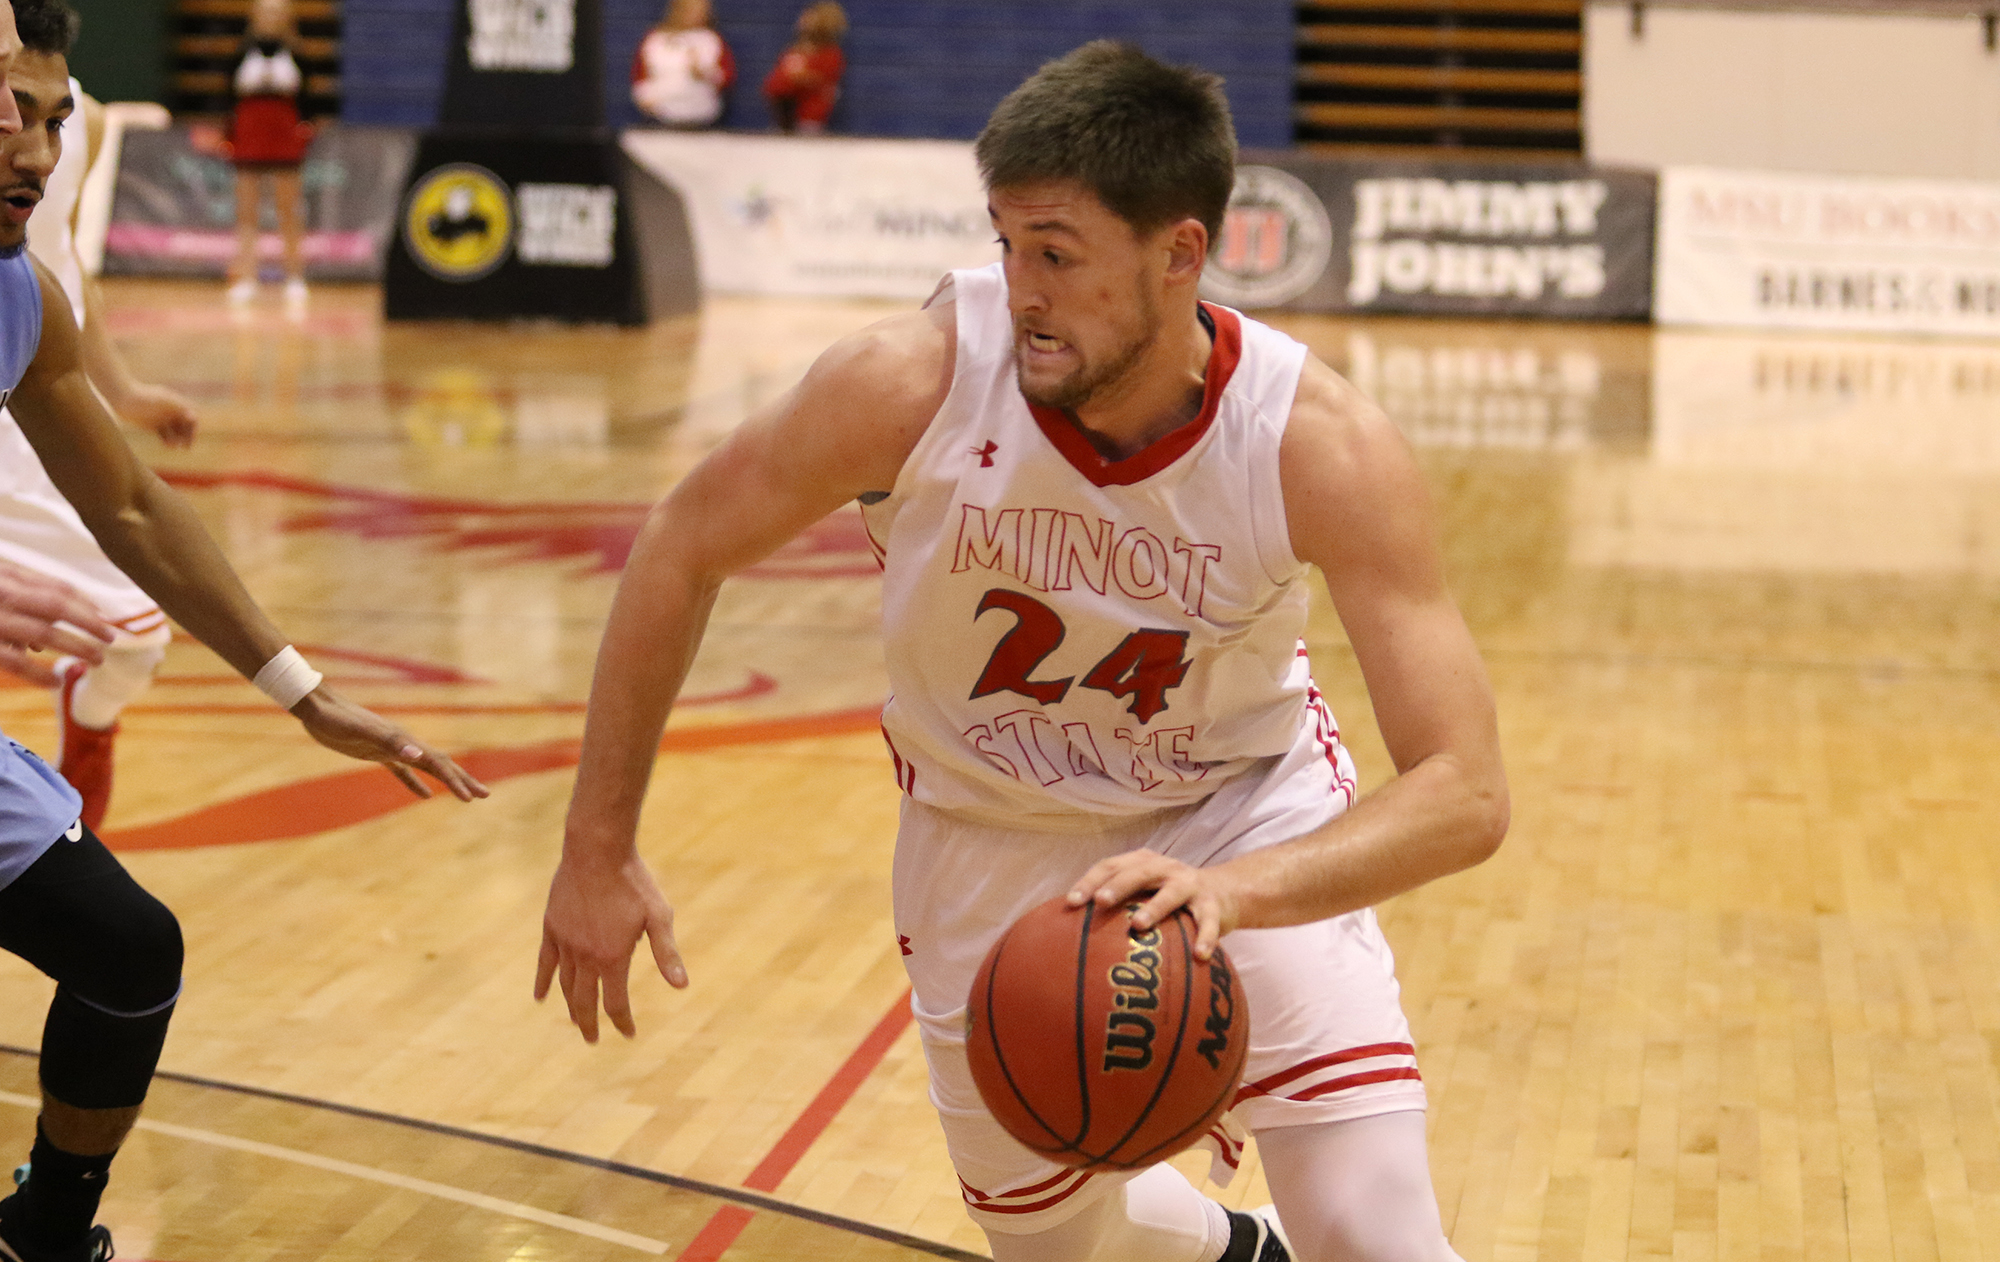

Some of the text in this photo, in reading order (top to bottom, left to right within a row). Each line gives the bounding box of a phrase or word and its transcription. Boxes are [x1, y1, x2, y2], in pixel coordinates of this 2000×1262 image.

[1353, 178, 1608, 239] JIMMY
[1346, 240, 1605, 304] JOHN'S
[1756, 267, 1905, 311] BARNES
[951, 504, 1221, 617] MINOT
[968, 588, 1194, 725] 24
[963, 709, 1210, 793] STATE
[1103, 900, 1164, 1075] Wilso
